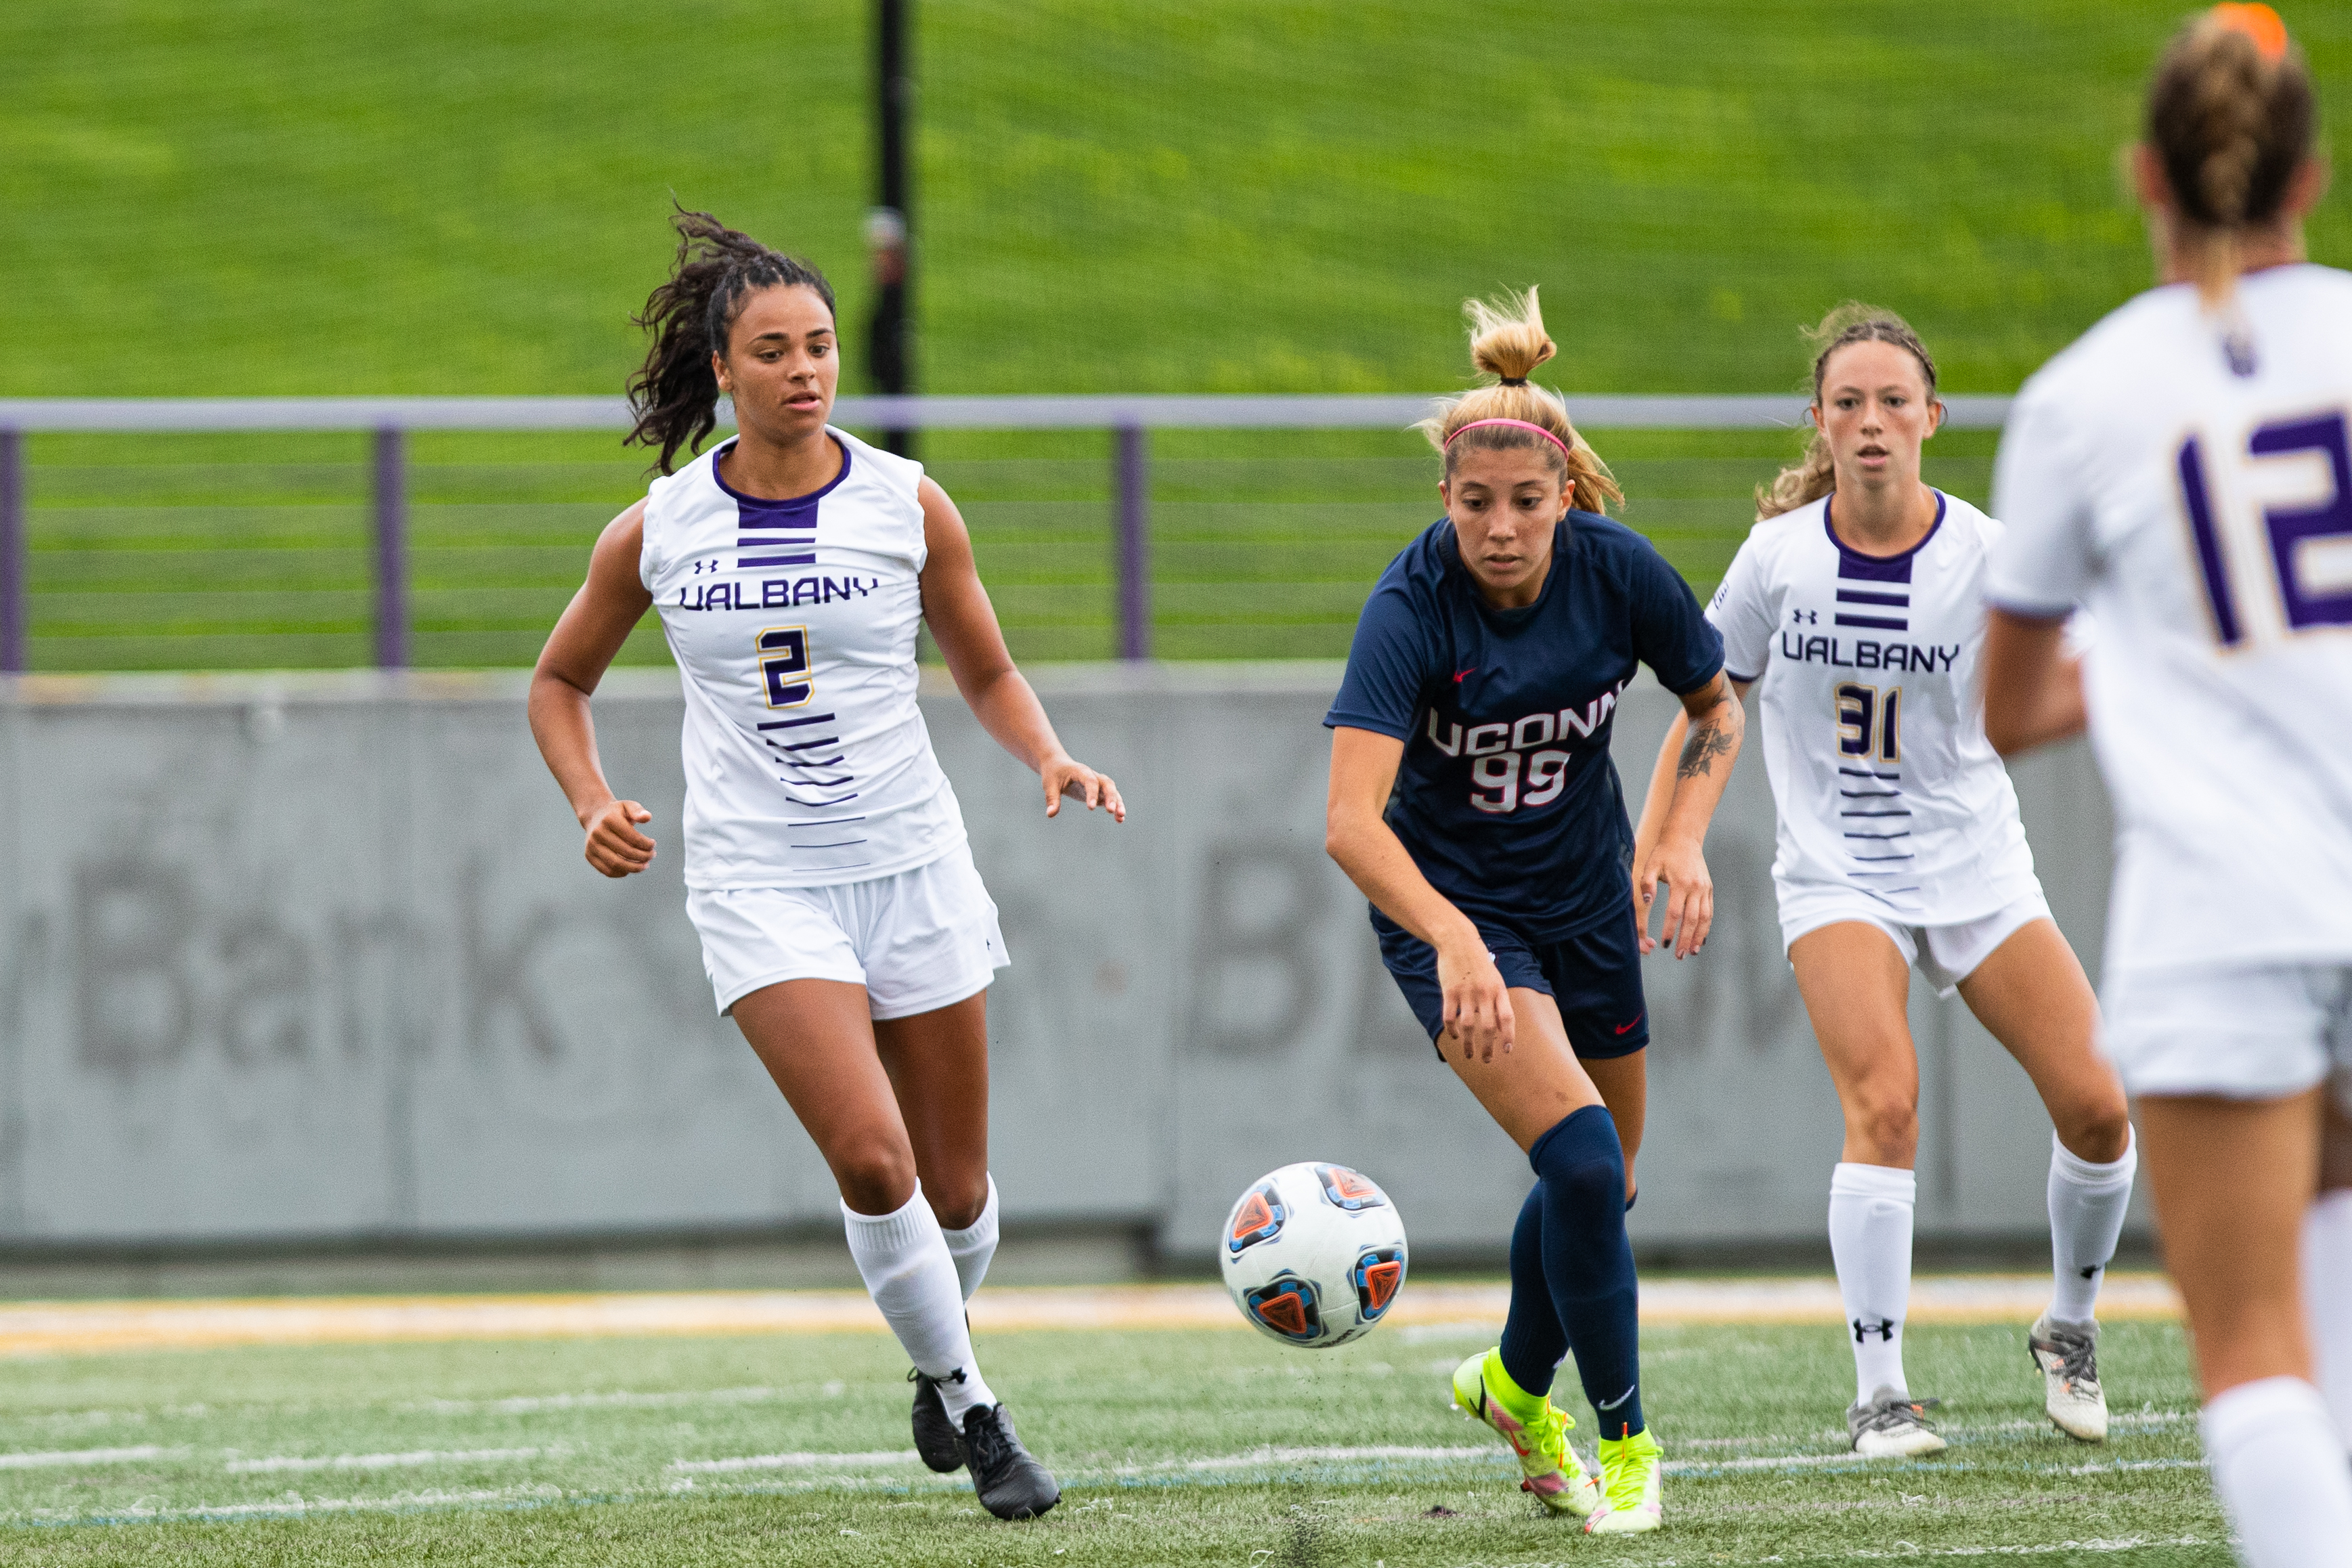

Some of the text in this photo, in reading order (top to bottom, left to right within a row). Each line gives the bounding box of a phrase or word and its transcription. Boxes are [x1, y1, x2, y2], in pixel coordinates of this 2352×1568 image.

[2171, 402, 2352, 655] 12
[679, 576, 879, 611] UALBANY
[755, 625, 814, 710] 2
[1782, 630, 1960, 673] UALBANY
[1833, 681, 1902, 764] 31
[1469, 749, 1572, 813] 99
